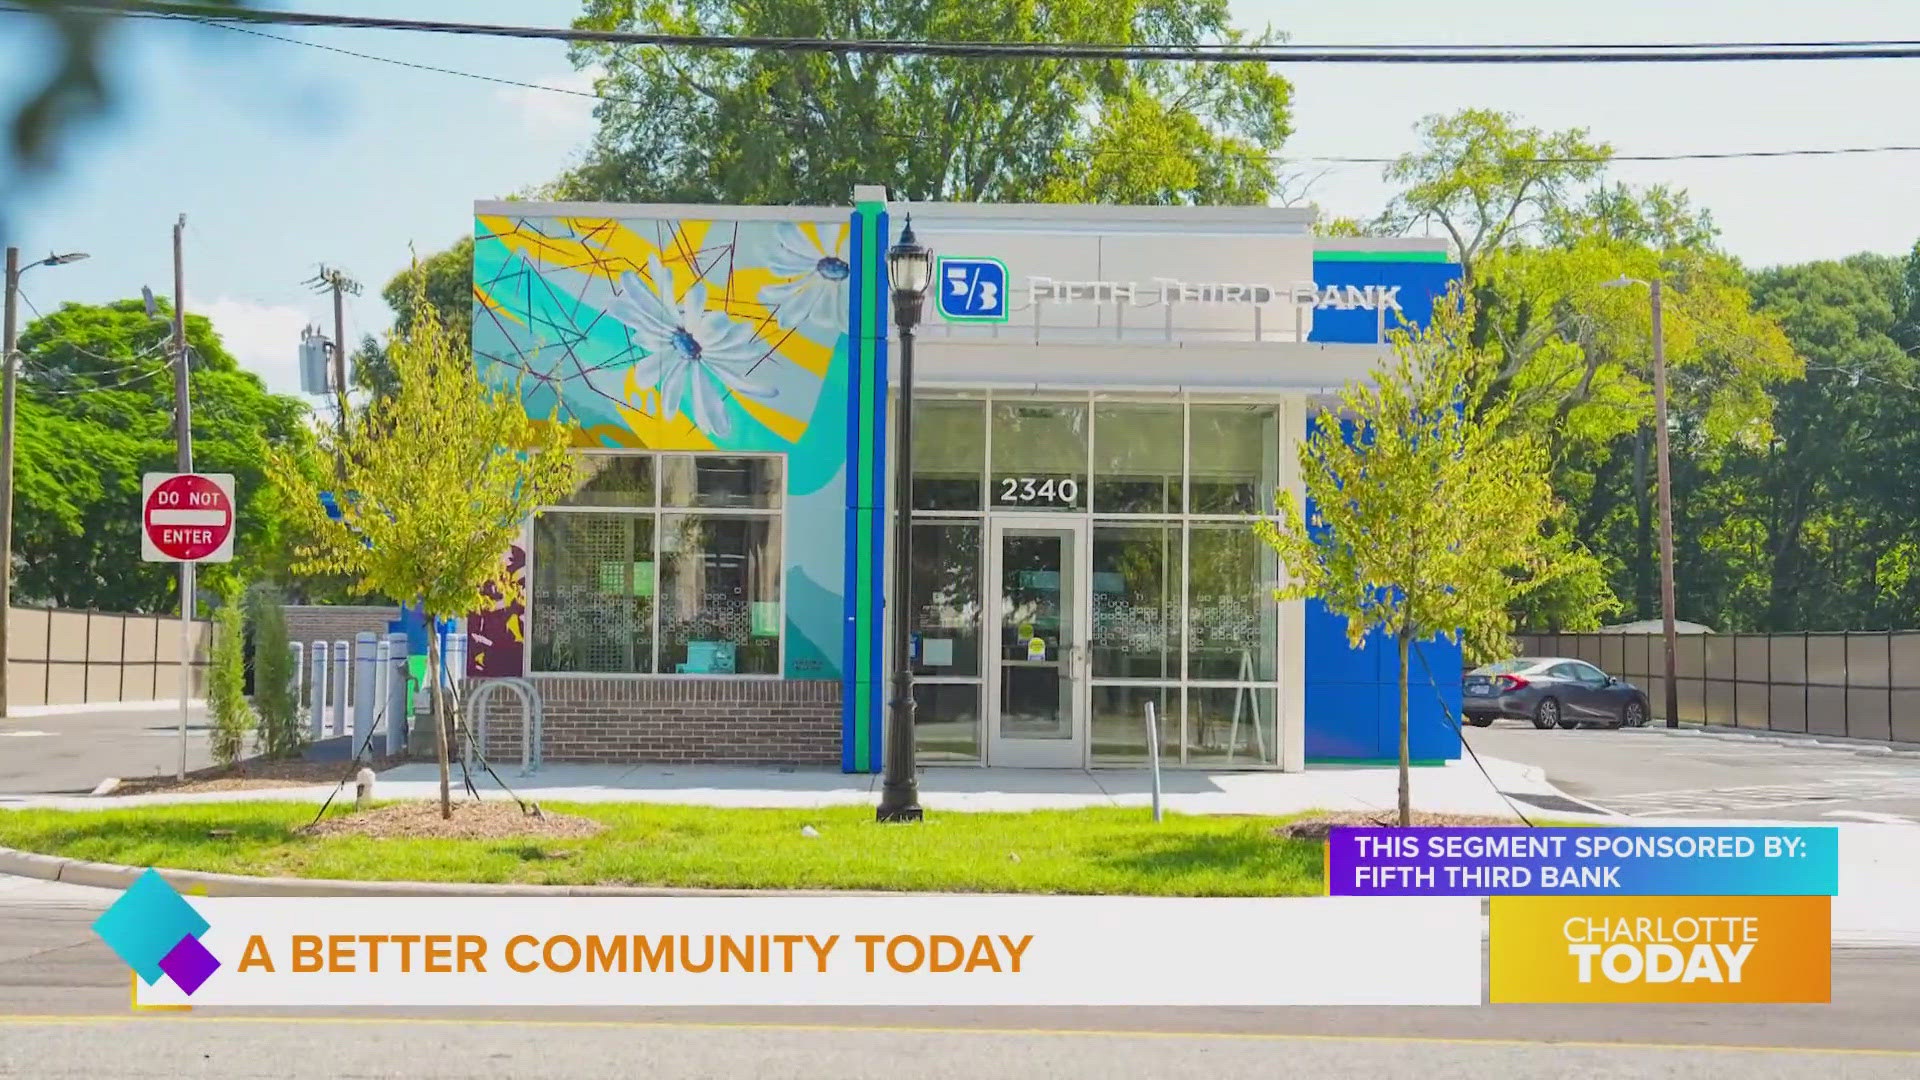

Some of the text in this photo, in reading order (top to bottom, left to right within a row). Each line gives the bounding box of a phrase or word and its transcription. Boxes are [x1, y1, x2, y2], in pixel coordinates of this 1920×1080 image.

[1026, 275, 1403, 310] FIFTH THIRD BANK
[158, 491, 220, 505] DO NOT
[1000, 477, 1078, 502] 2340
[163, 528, 212, 544] ENTER
